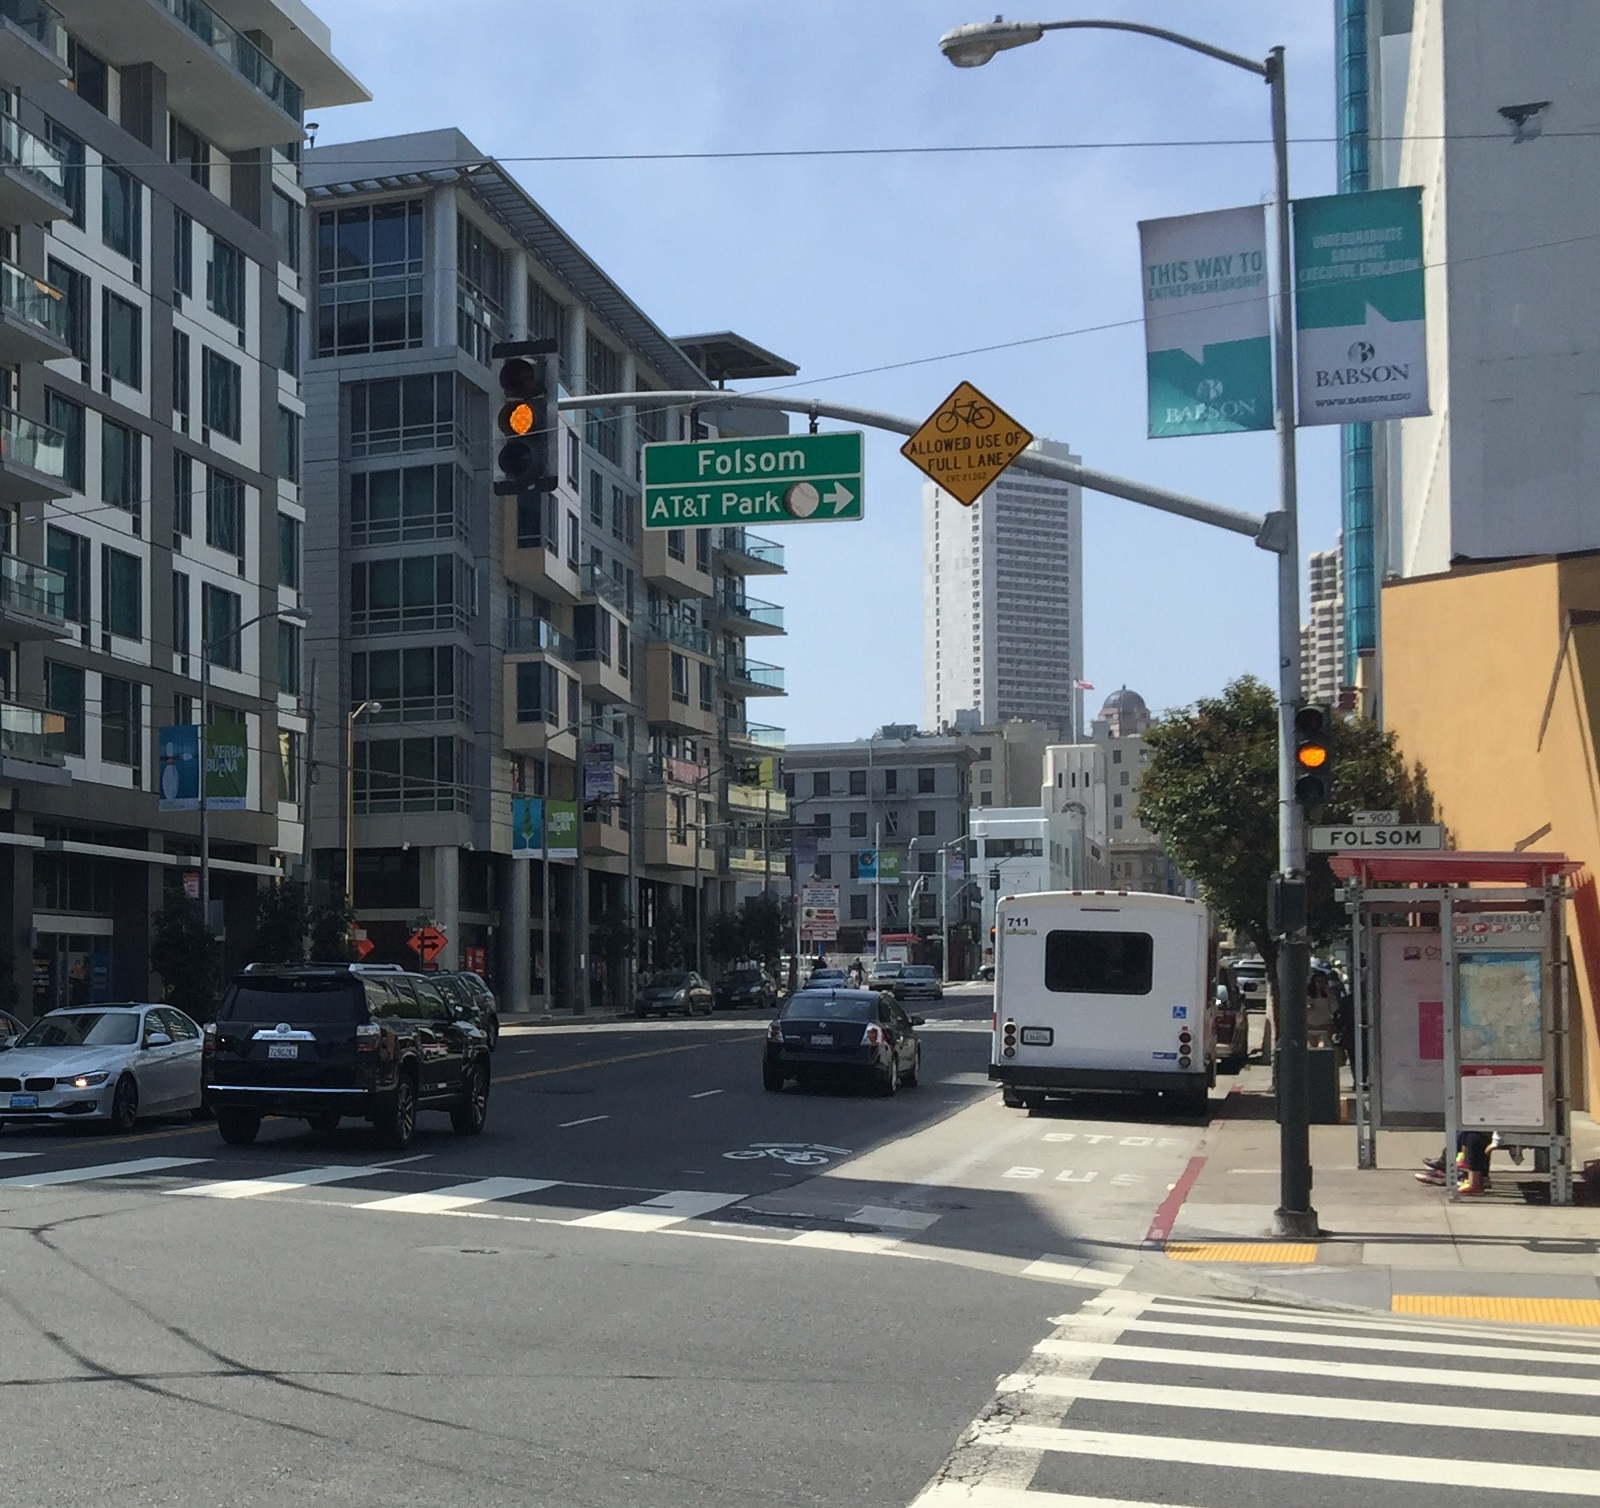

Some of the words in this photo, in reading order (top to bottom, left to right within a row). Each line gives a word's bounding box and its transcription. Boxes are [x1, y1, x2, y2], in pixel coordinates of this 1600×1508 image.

[1148, 261, 1189, 285] THIS
[1194, 254, 1233, 279] WAY
[1239, 250, 1263, 273] TO
[1316, 364, 1410, 387] BABSON
[1165, 399, 1256, 423] BABSON
[910, 436, 971, 455] ALLOWED
[976, 433, 1001, 449] USE
[1005, 431, 1022, 446] OF
[698, 448, 805, 476] Folsom
[928, 456, 961, 472] FULL
[968, 452, 1004, 469] LANE
[651, 494, 711, 519] AT&T
[721, 490, 781, 516] Park
[213, 745, 244, 758] YERBA
[1369, 812, 1393, 823] 900
[1330, 830, 1421, 846] FOLSOM
[1007, 917, 1029, 927] 711
[1001, 1165, 1150, 1186] BUS
